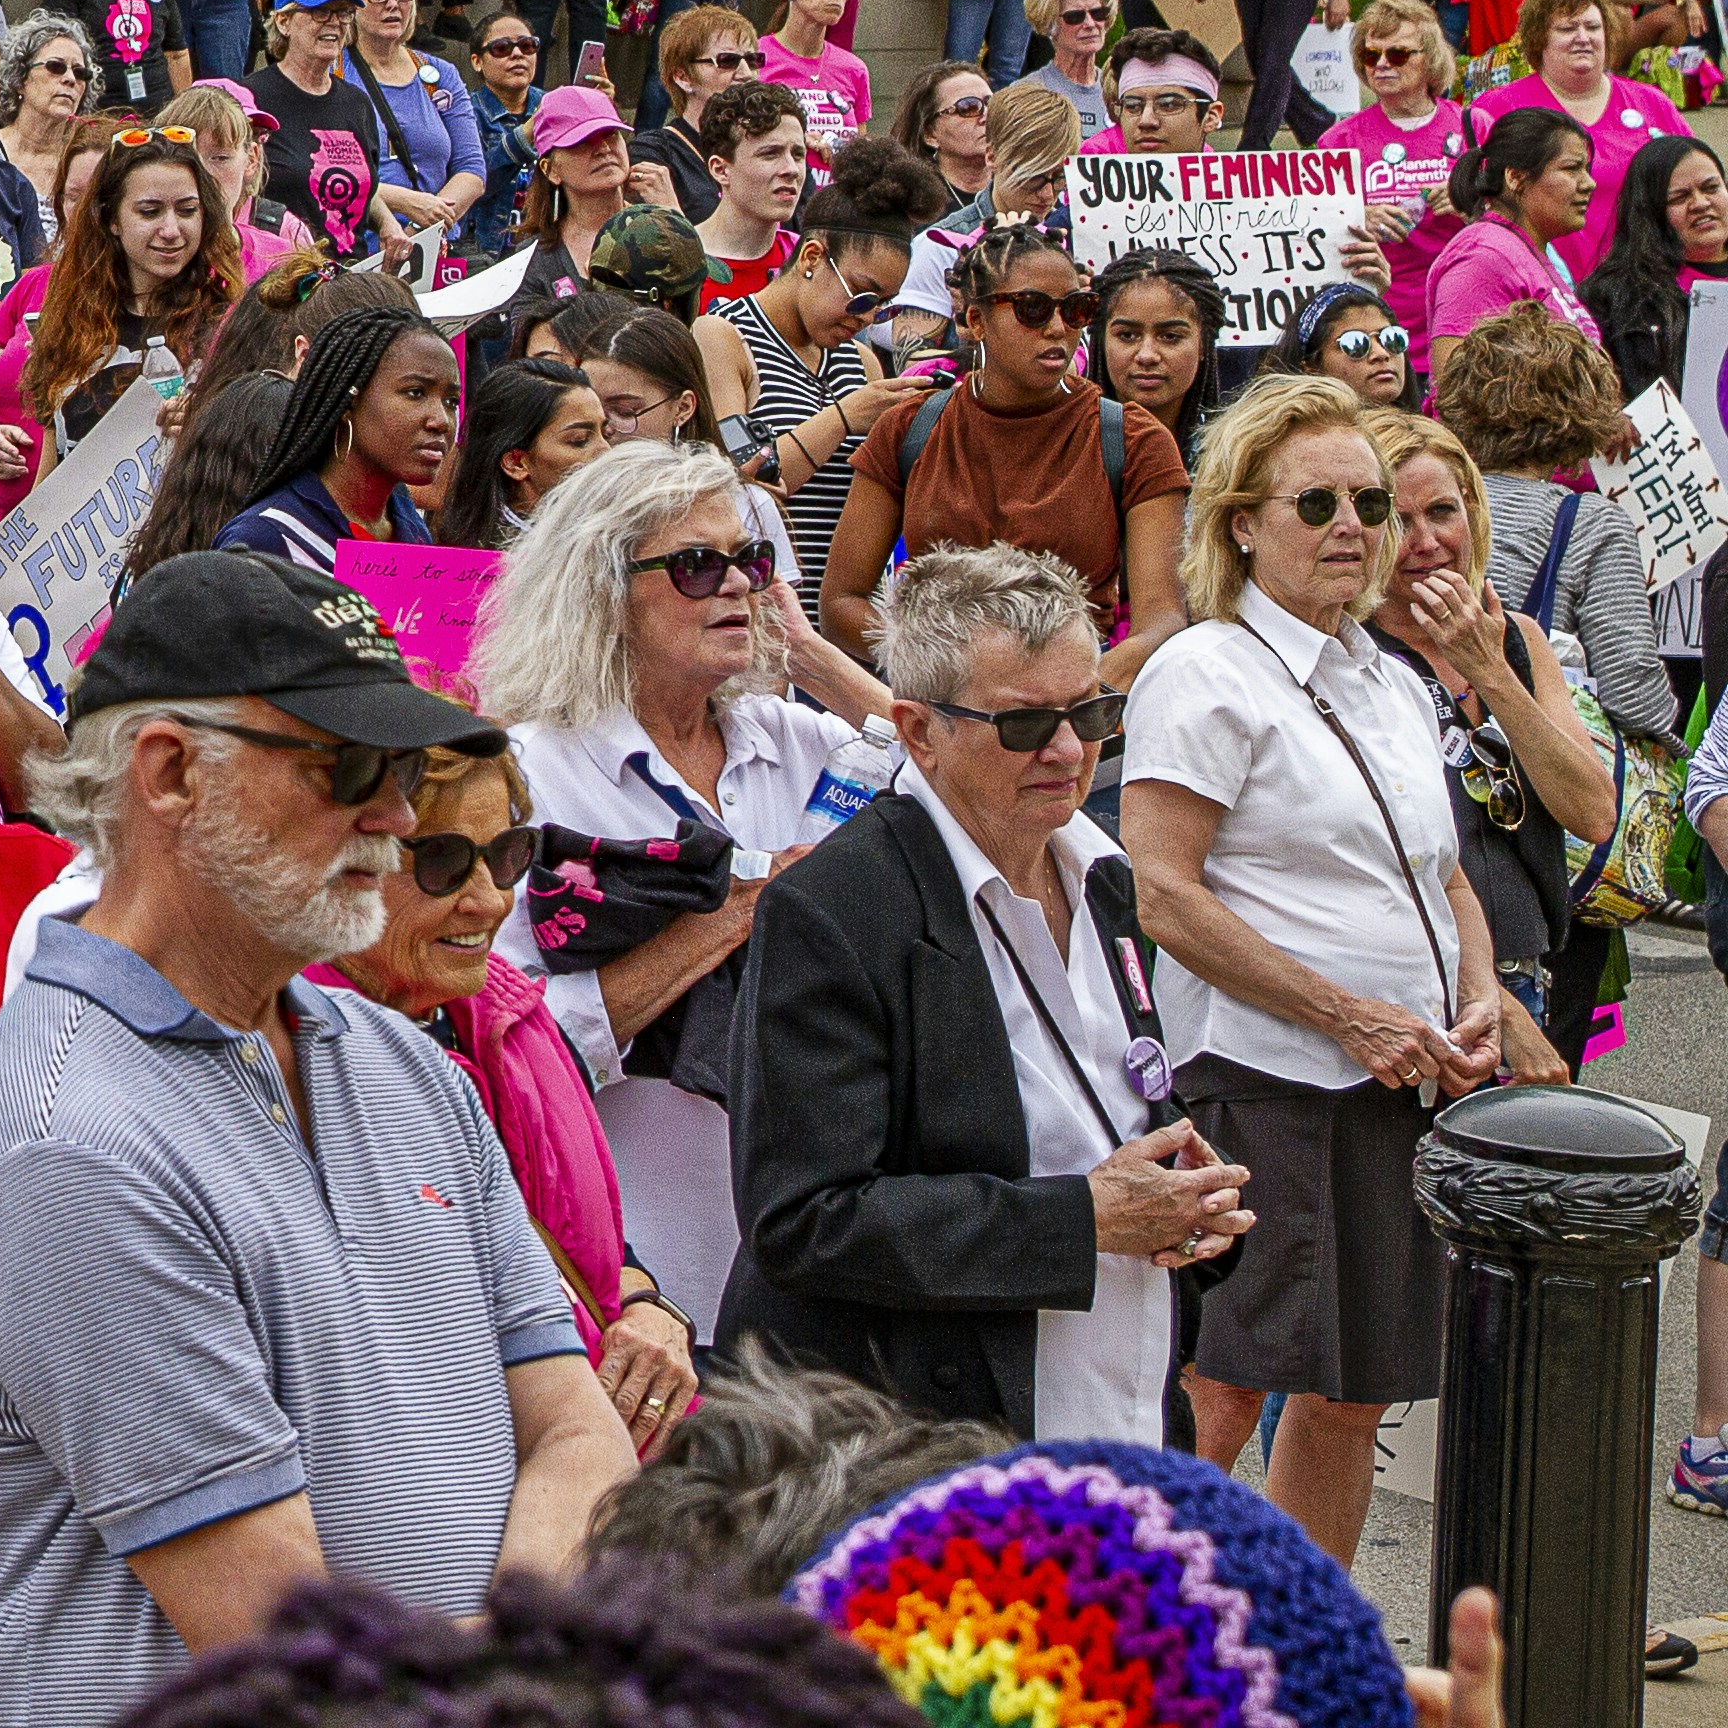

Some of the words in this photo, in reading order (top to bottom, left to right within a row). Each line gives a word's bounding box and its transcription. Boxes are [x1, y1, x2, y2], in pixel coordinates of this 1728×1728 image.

[1077, 156, 1175, 209] YOUR
[1177, 151, 1356, 202] FEMINISM
[1178, 202, 1232, 233] NOT
[1629, 440, 1691, 558] HER!
[1652, 418, 1685, 472] I'M
[1677, 470, 1714, 534] WITH
[413, 562, 448, 581] to
